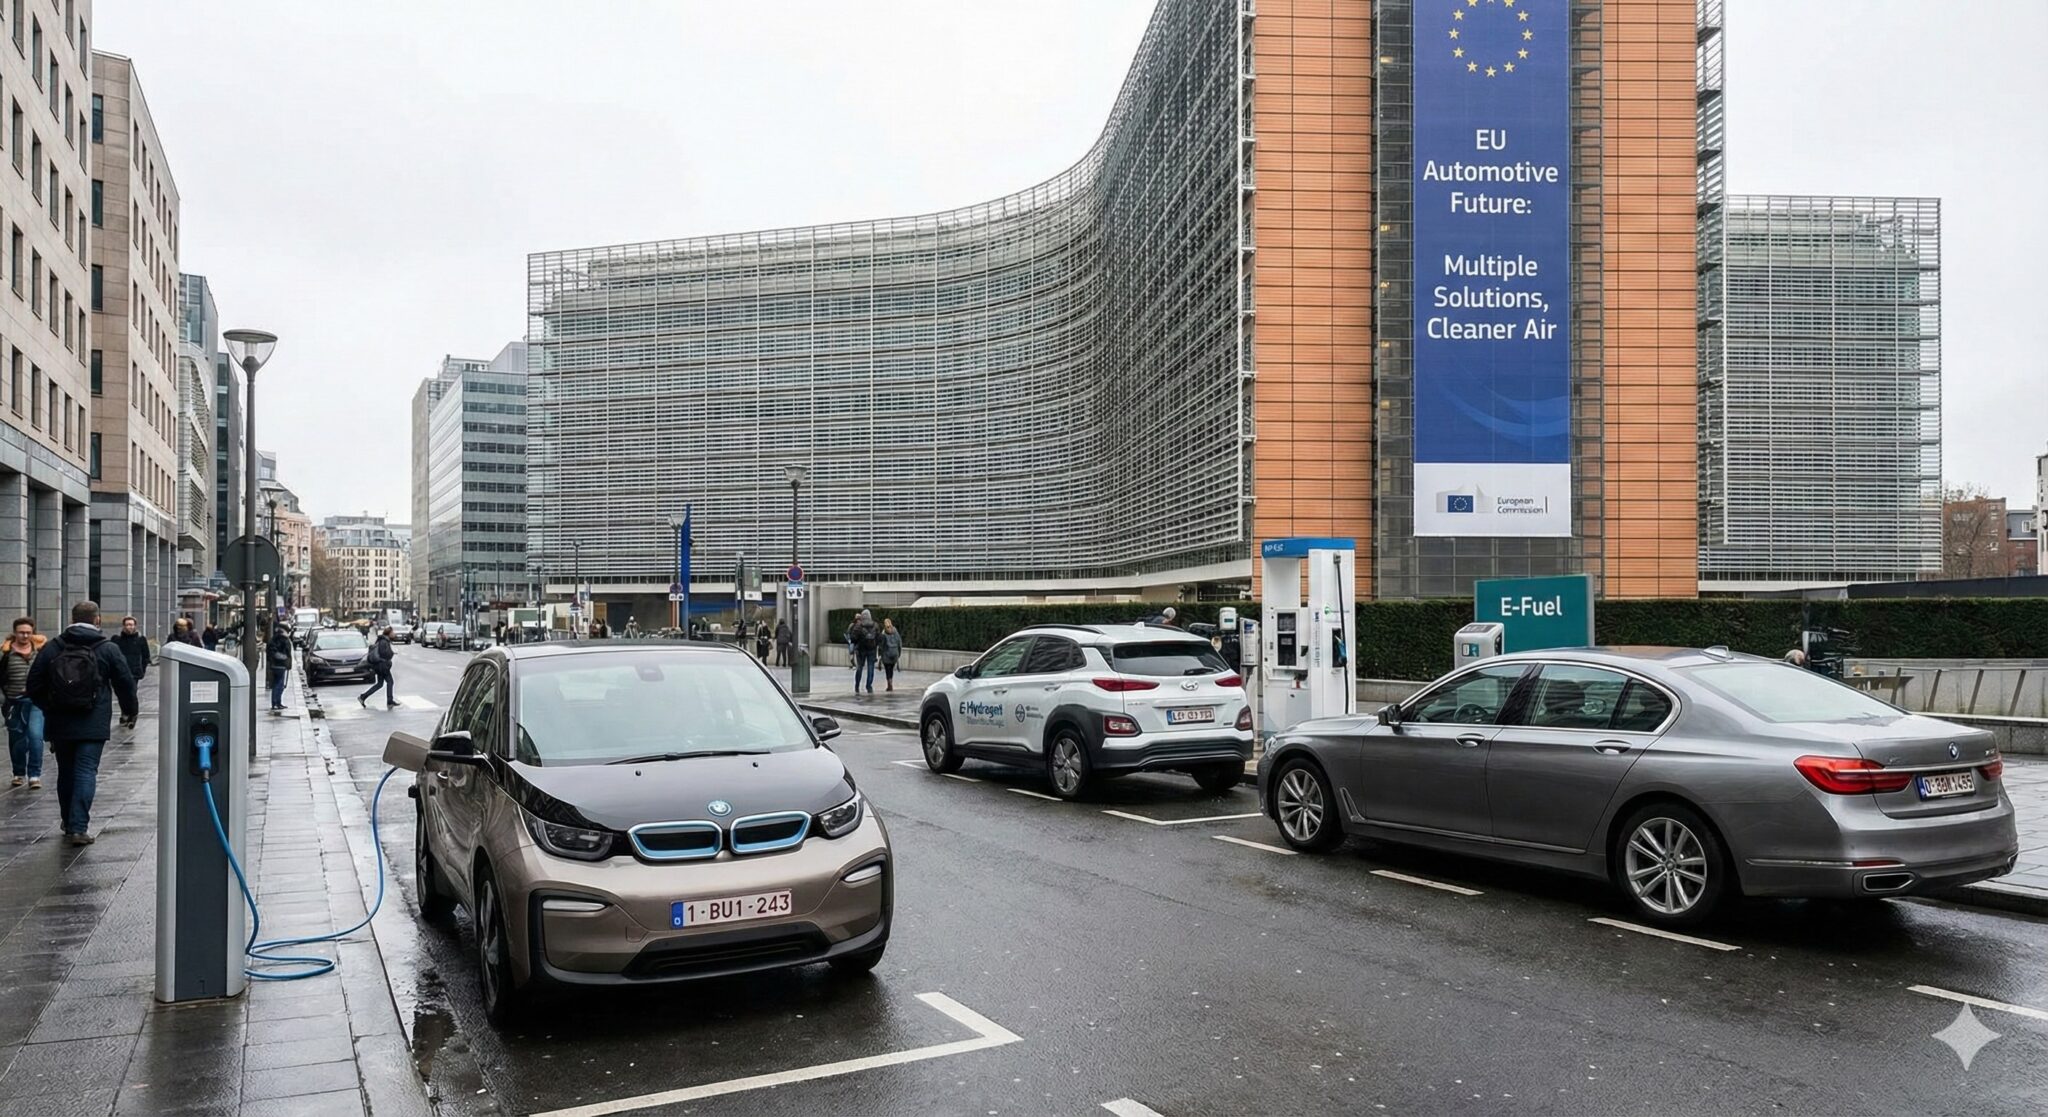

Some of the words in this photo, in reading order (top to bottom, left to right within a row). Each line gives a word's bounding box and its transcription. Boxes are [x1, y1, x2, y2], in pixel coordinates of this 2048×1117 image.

[1476, 129, 1506, 150] EU
[1423, 160, 1559, 182] Automotive
[1451, 191, 1532, 214] Future:
[1444, 254, 1538, 281] Multiple
[1434, 286, 1549, 312] Solutions,
[1427, 317, 1516, 340] Cleaner
[1523, 319, 1557, 340] Air
[1497, 496, 1534, 506] European
[1501, 595, 1563, 617] E-Fuel
